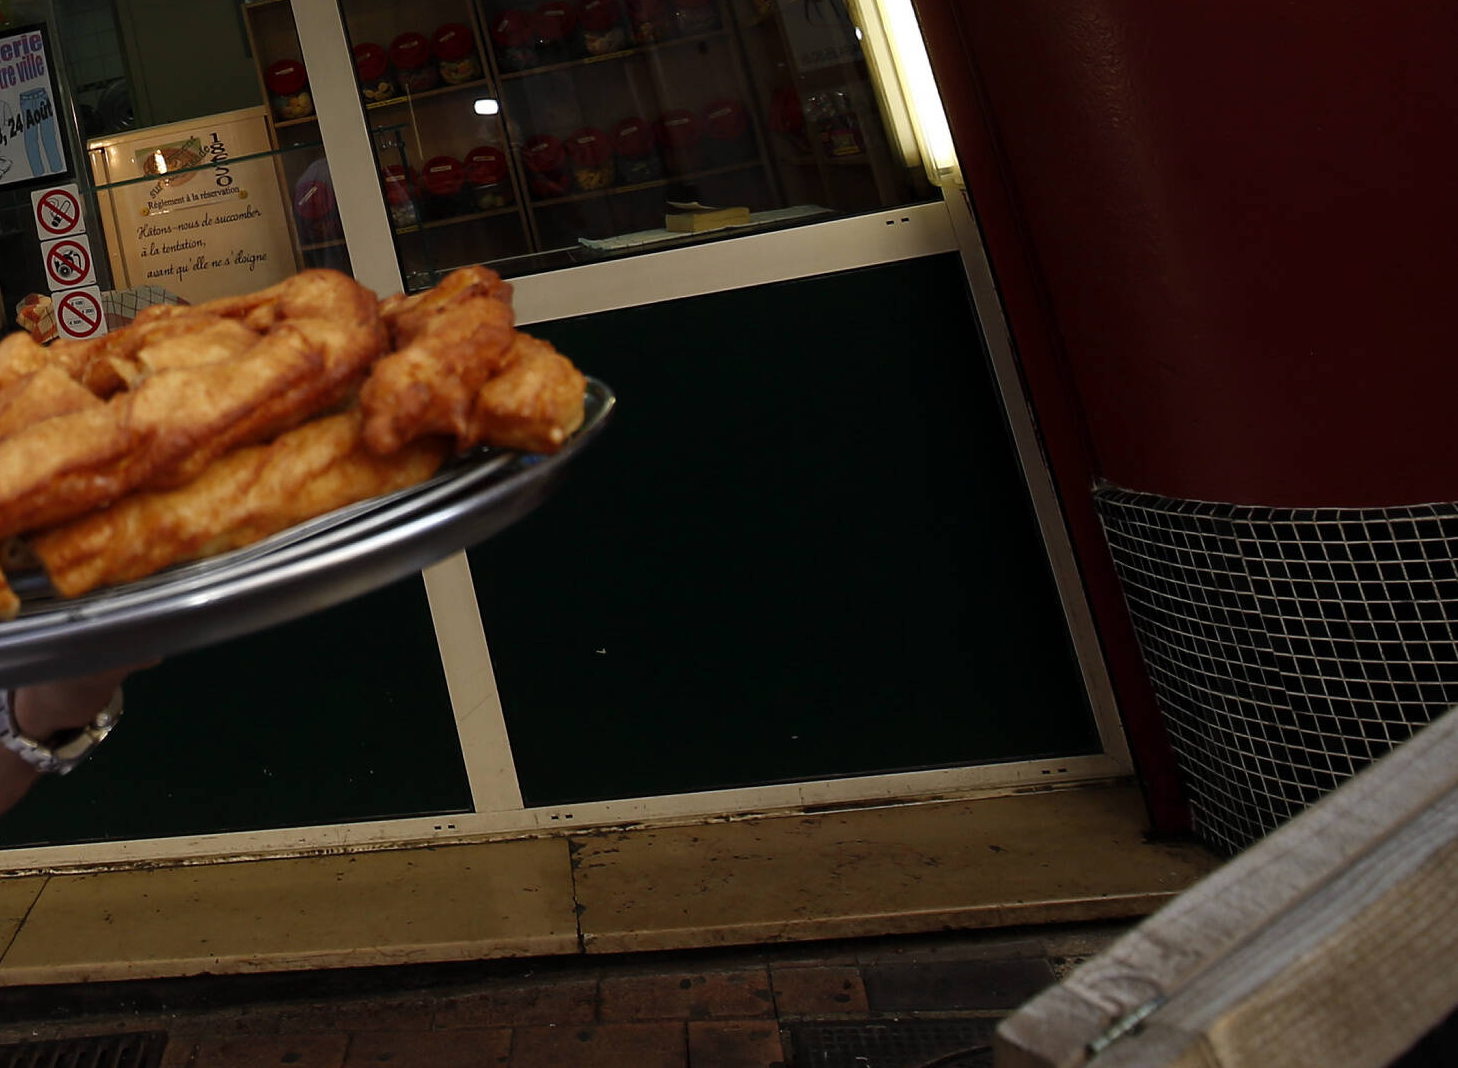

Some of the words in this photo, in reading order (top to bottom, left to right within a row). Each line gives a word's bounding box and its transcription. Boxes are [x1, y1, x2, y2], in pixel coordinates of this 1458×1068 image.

[16, 53, 45, 83] ville
[8, 113, 23, 138] 24
[148, 195, 184, 211] Règlement
[186, 193, 191, 203] à
[192, 191, 200, 201] la
[200, 186, 240, 199] réservation
[201, 213, 212, 227] de
[141, 247, 148, 257] à
[150, 242, 160, 256] la
[147, 265, 174, 279] avant
[212, 258, 223, 268] ne
